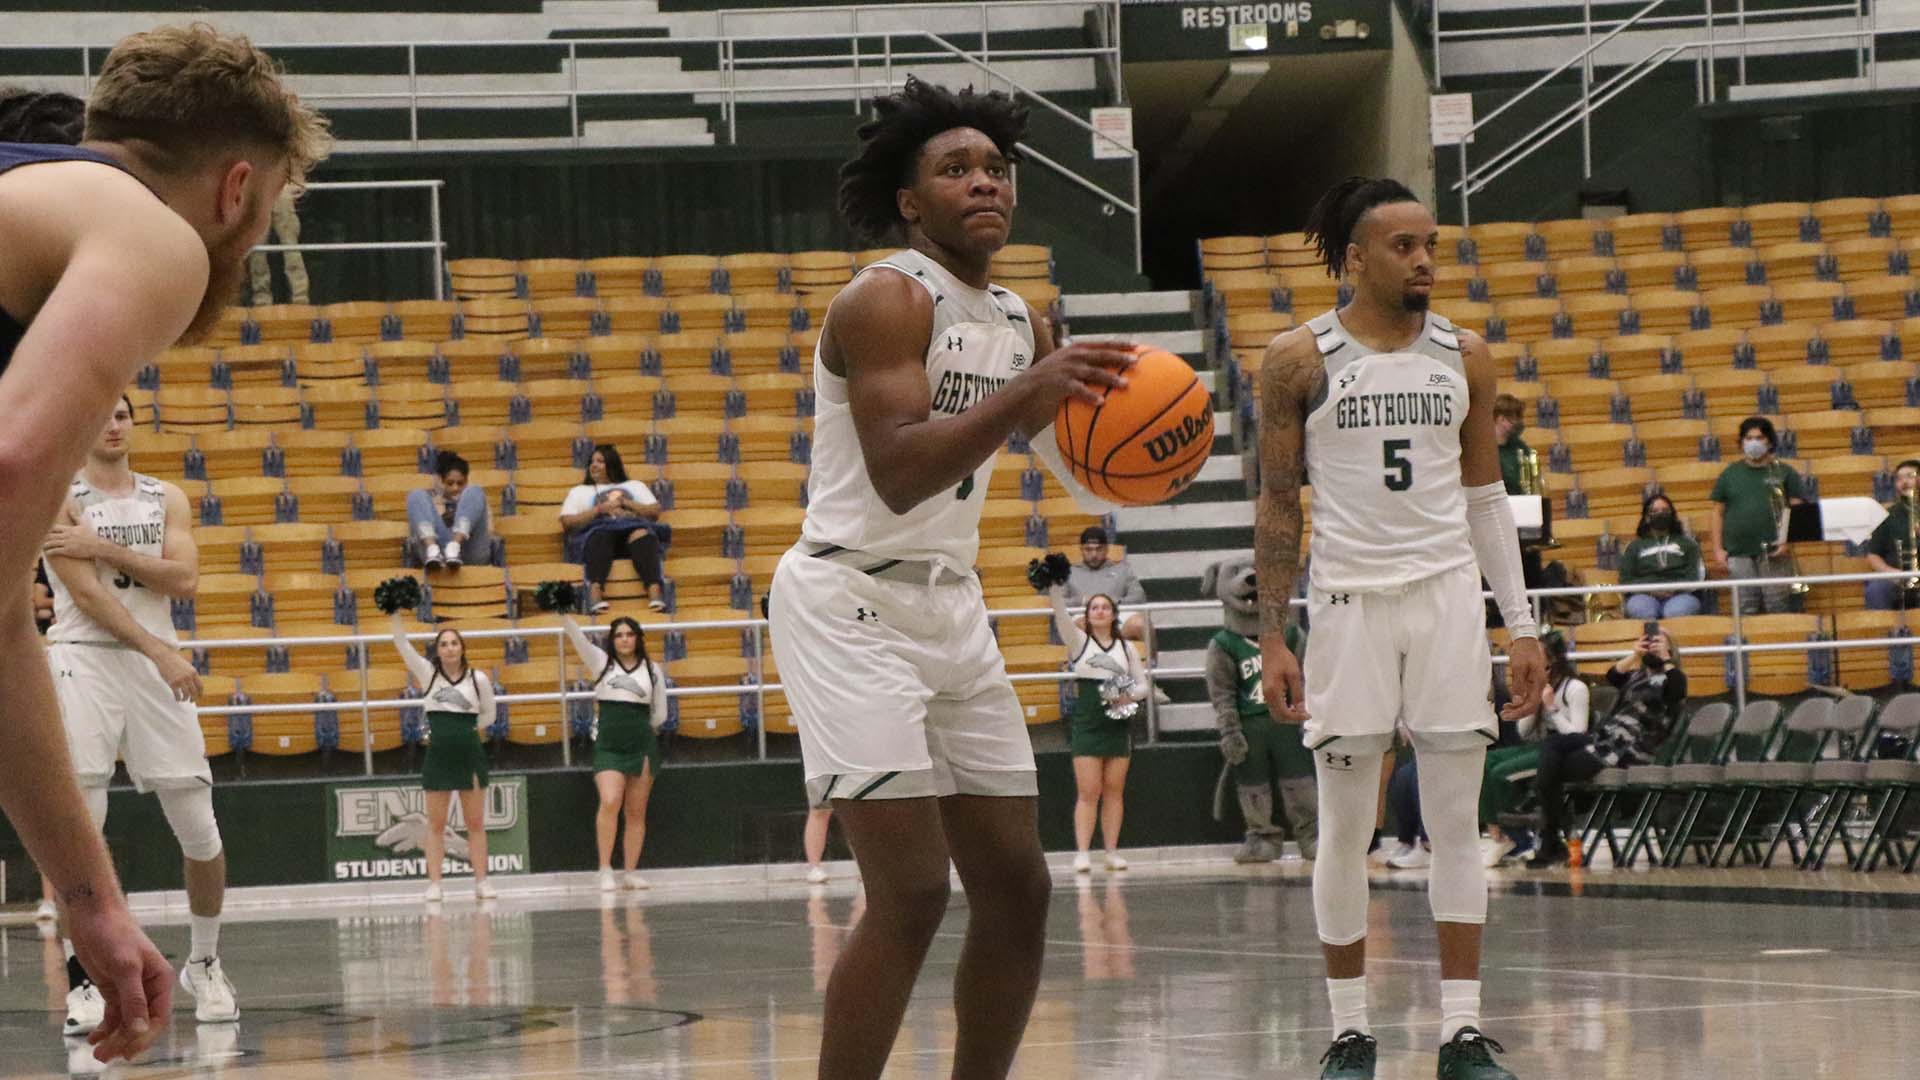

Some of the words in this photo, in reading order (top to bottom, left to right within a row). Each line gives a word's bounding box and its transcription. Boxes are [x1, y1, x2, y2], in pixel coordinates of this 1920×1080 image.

[1181, 2, 1312, 29] RESTROOMS
[1336, 392, 1452, 429] GREYHOUNDS
[1142, 397, 1212, 463] Wilso
[1383, 439, 1413, 491] 5
[334, 857, 428, 879] STUDENT
[441, 853, 523, 875] SECION
